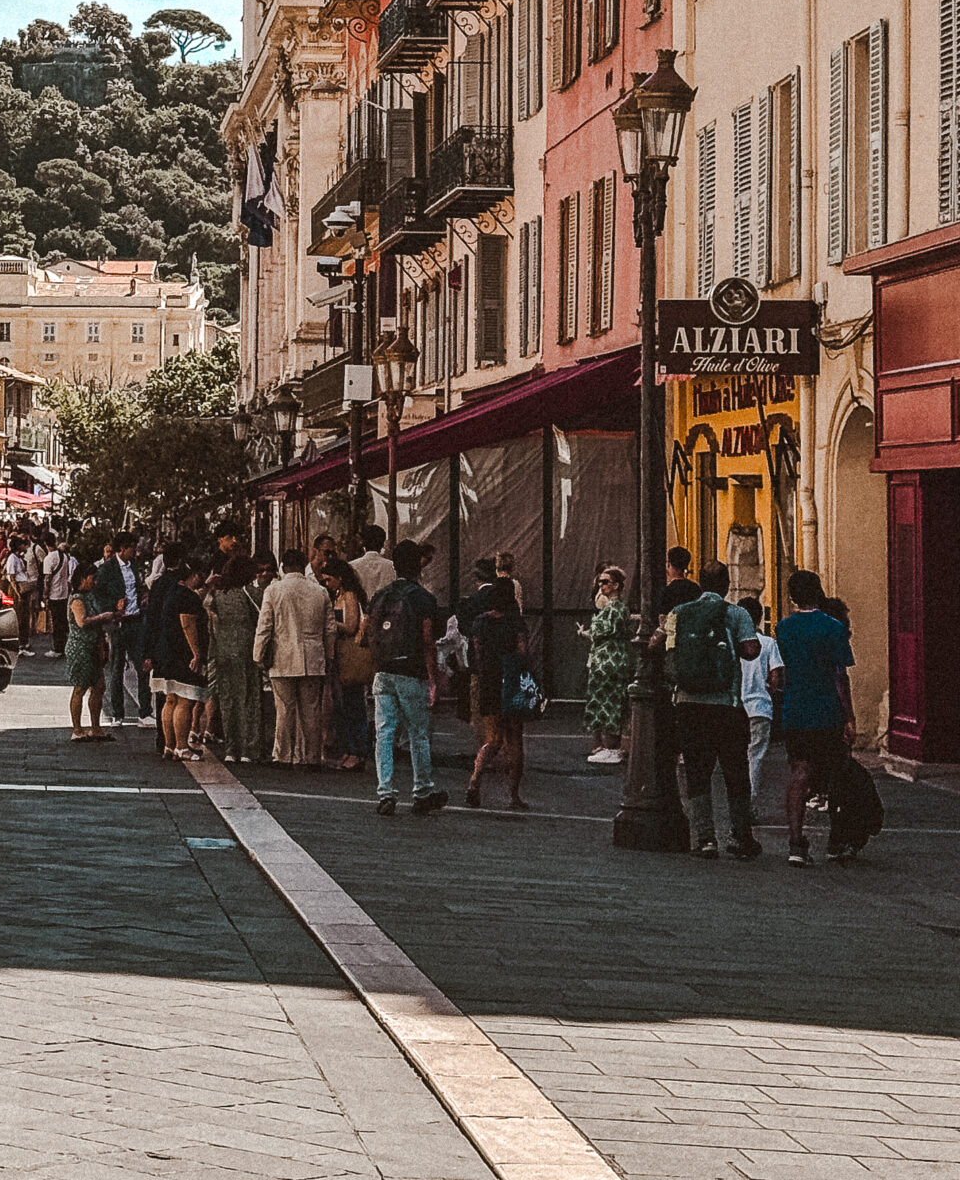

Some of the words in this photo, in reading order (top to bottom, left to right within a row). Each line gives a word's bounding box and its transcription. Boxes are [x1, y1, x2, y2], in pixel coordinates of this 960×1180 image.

[670, 327, 800, 354] ALZIARI
[690, 356, 732, 373] Huile
[733, 356, 780, 373] d'Olive
